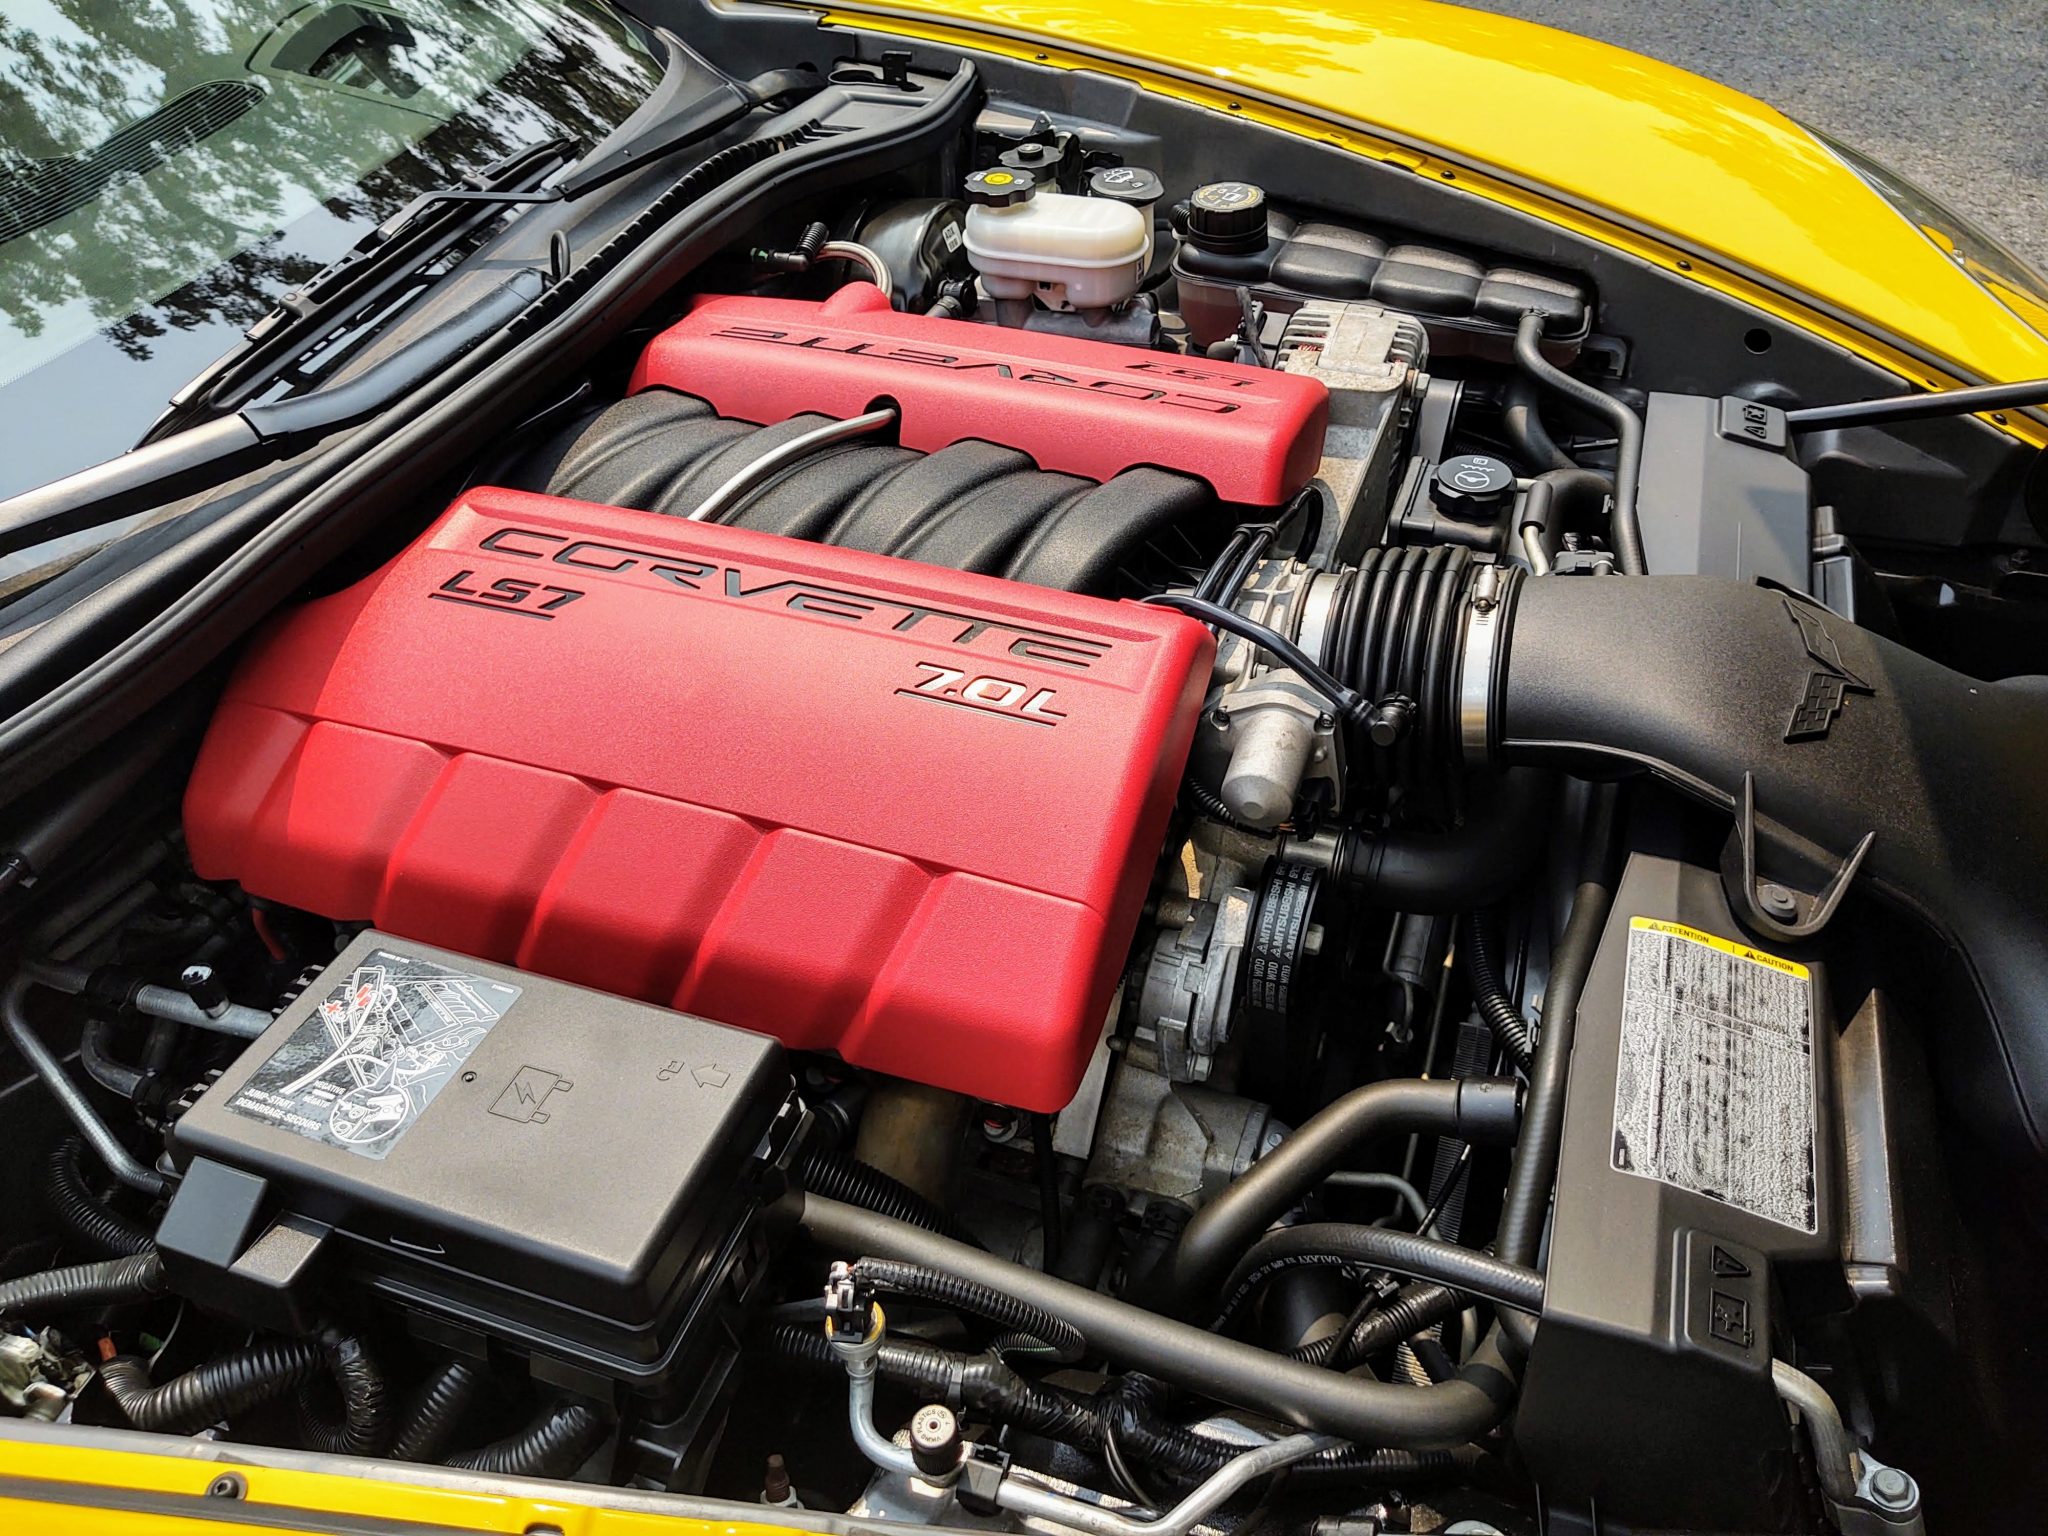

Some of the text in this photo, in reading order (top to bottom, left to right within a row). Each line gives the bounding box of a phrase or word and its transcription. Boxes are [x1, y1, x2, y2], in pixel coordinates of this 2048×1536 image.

[710, 327, 1242, 414] CORVETTE
[1125, 361, 1263, 388] LS7
[439, 569, 586, 611] LS7
[479, 527, 1112, 670] CORVETTE
[914, 661, 1068, 720] 7.0L
[1661, 925, 1710, 944] ATTENTION
[1756, 954, 1795, 973] CAUTION
[244, 1087, 296, 1109] JUMP-START
[312, 1079, 347, 1096] NEGATIVE
[235, 1096, 321, 1131] DEMARRAGE-SECOURS
[1298, 1255, 1342, 1265] GALAXY
